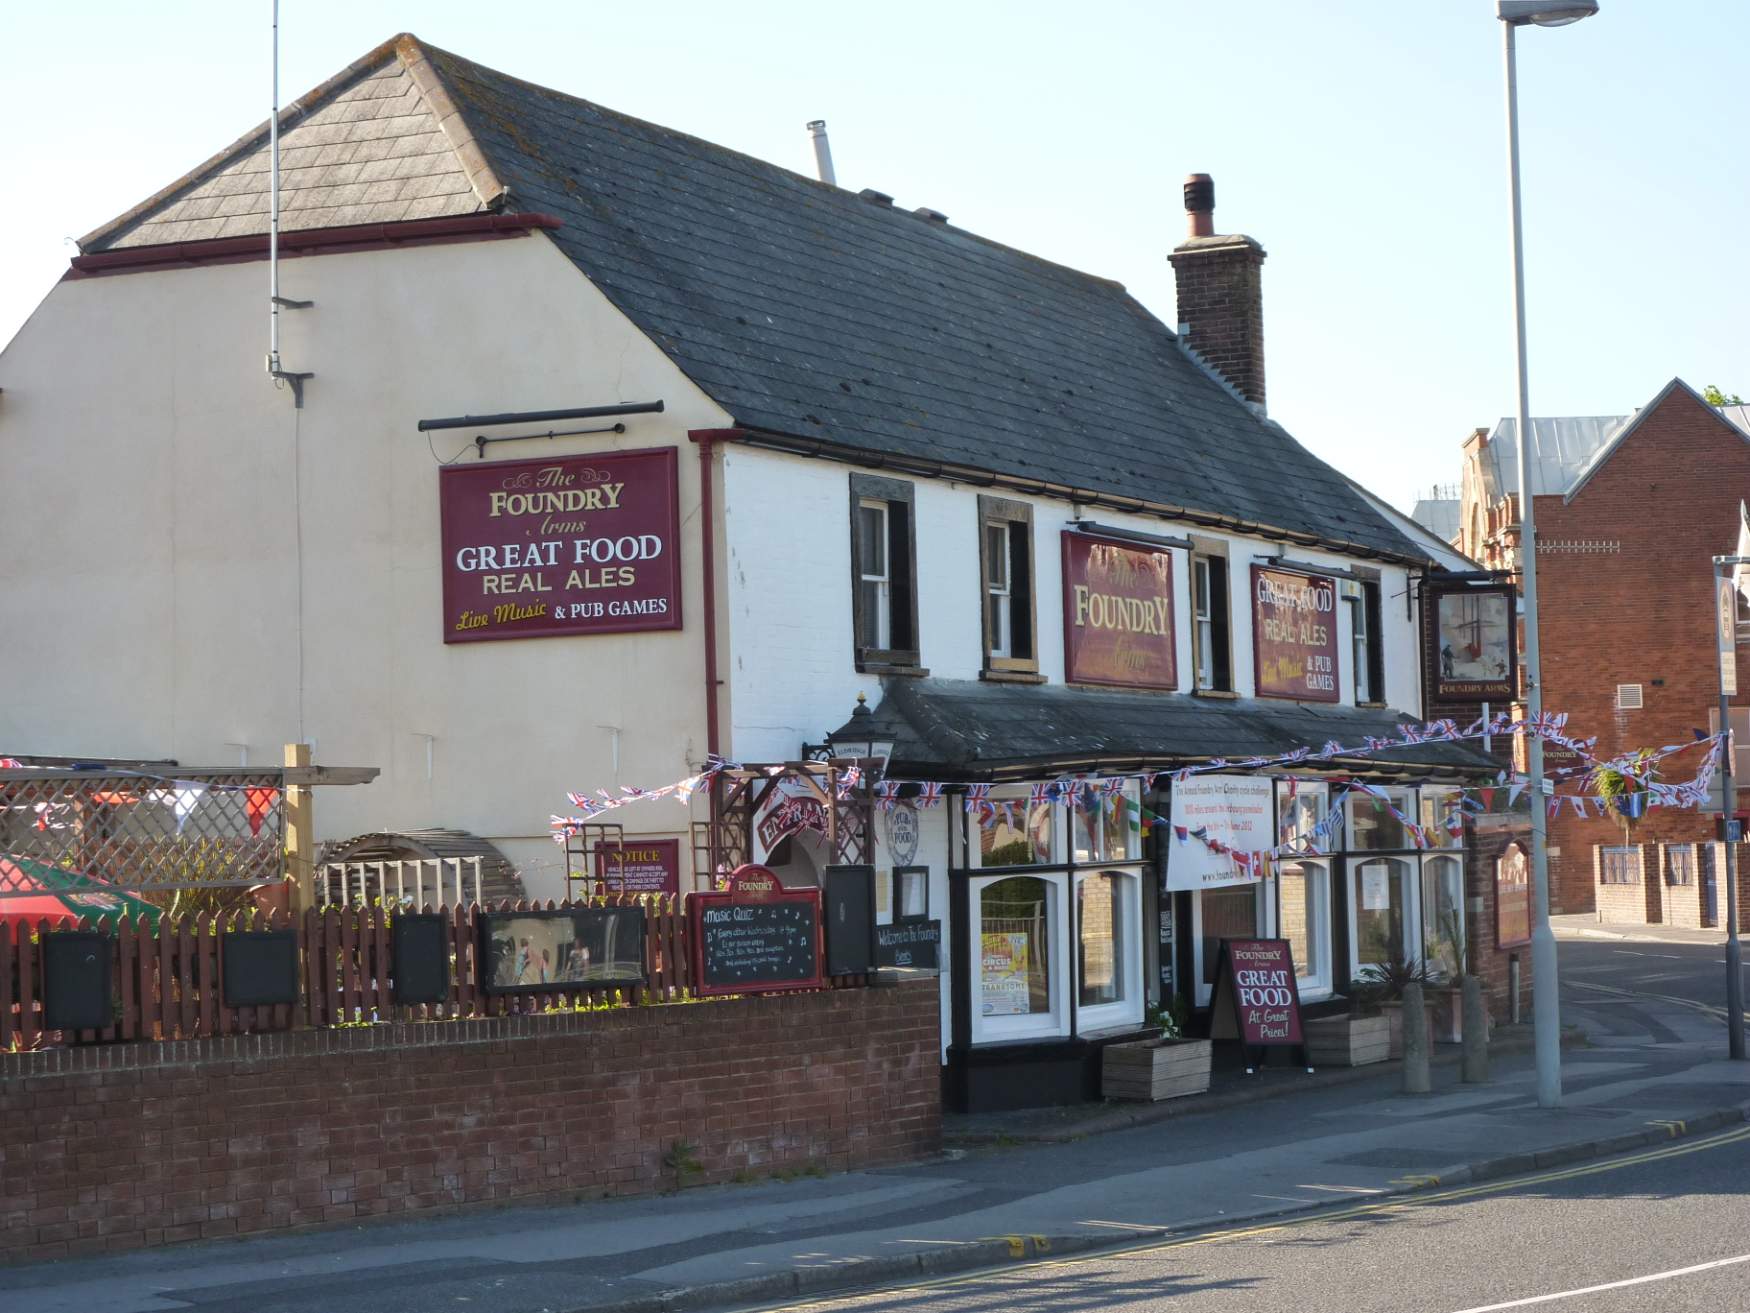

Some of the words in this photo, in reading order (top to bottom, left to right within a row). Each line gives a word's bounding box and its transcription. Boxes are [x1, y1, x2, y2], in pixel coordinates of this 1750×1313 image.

[536, 467, 575, 488] The
[489, 483, 624, 517] FOUNDRY
[526, 515, 586, 536] Arms
[456, 541, 563, 572] GREAT
[574, 535, 662, 564] FOOD
[483, 572, 552, 595] REAL
[565, 566, 635, 590] ALES
[1257, 577, 1297, 608] GREAT
[1299, 586, 1333, 612] FOOD
[455, 610, 489, 631] Live
[494, 599, 547, 624] Music
[555, 606, 565, 619] &
[571, 602, 604, 618] PUB
[608, 598, 668, 616] GAMES
[1074, 584, 1169, 635] FOUNDRY
[1264, 618, 1296, 643] REAL
[1300, 623, 1327, 646] ALES
[1306, 655, 1314, 671] &
[1315, 655, 1332, 672] PUB
[1306, 673, 1334, 691] GAMES
[1439, 684, 1482, 694] FOUNDRY
[1485, 683, 1511, 693] ARMS
[894, 832, 912, 844] FOOD
[738, 880, 774, 891] FOUNDRY
[1235, 950, 1281, 960] FOUNDRY
[1237, 970, 1288, 986] GREAT
[1239, 987, 1292, 1007] FOOD
[1248, 1009, 1261, 1024] At
[1264, 1008, 1291, 1022] Great
